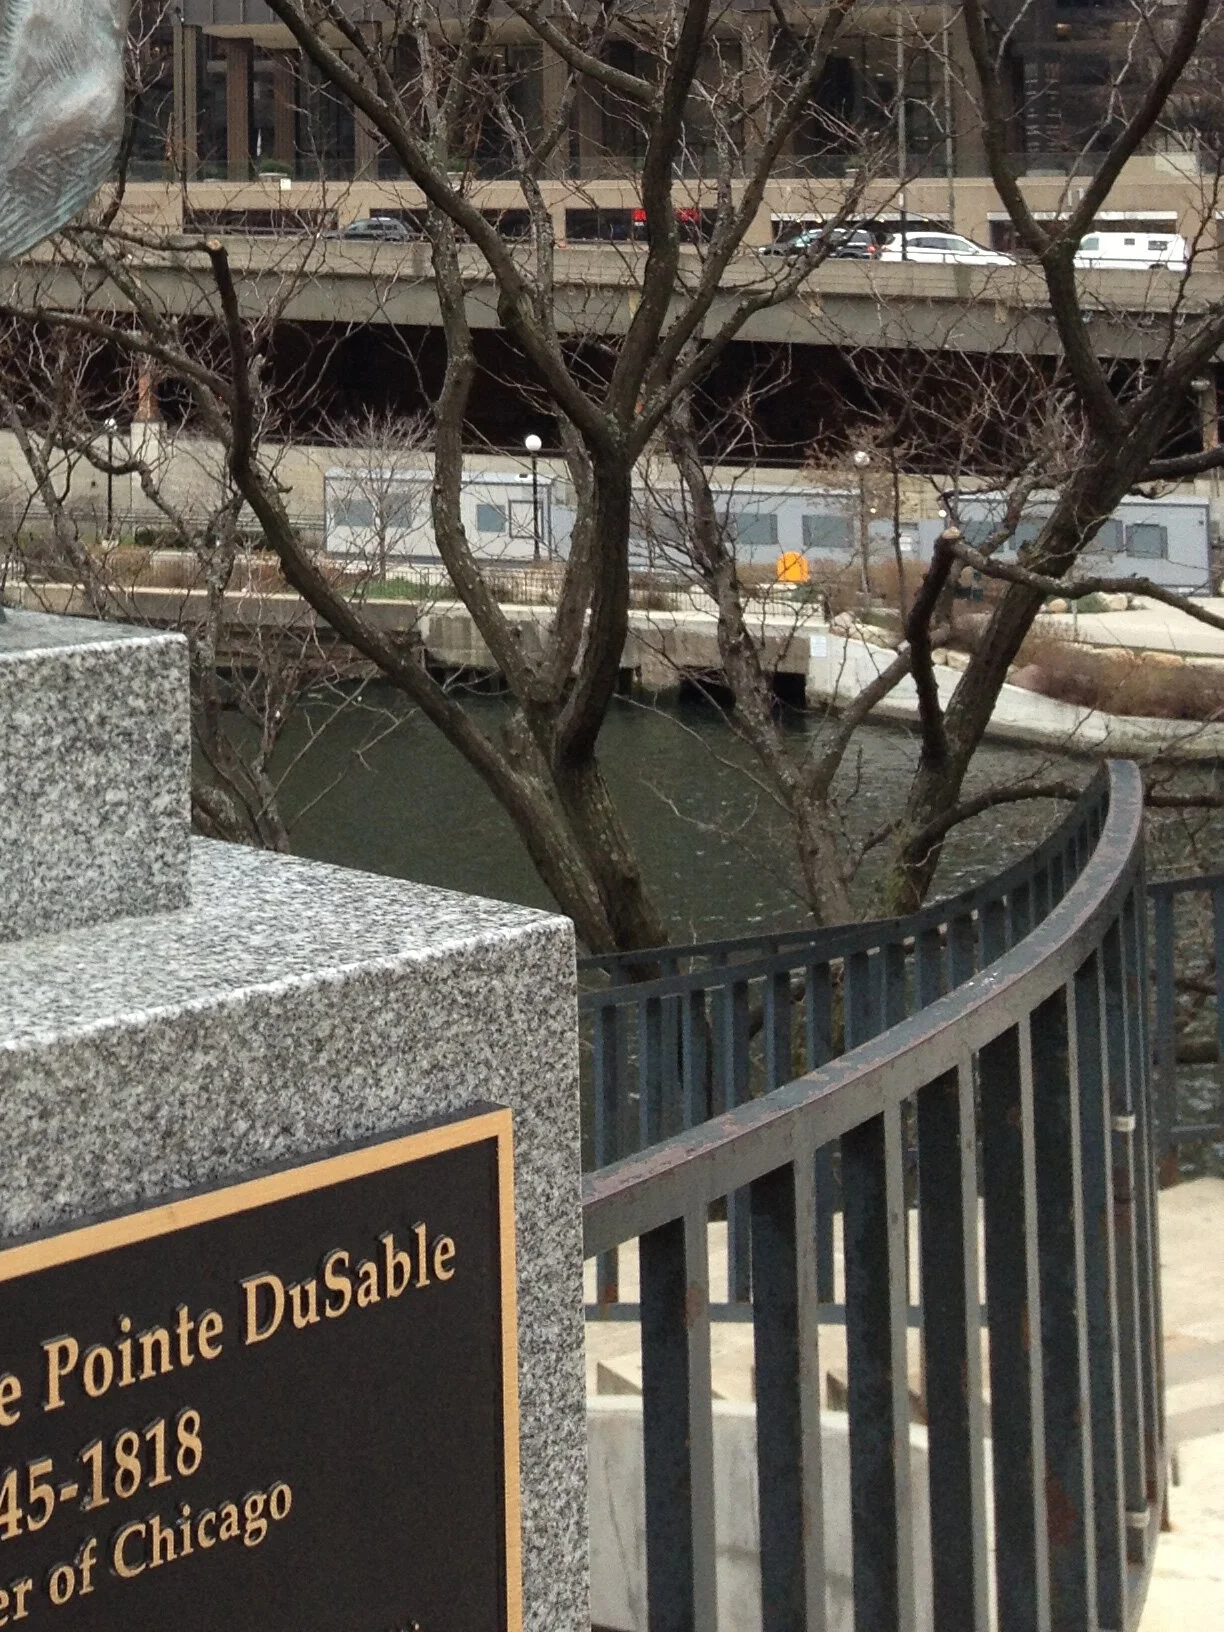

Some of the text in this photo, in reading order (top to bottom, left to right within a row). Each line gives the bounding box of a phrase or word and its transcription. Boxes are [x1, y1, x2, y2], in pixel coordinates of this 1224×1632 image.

[42, 1304, 225, 1413] Pointe
[241, 1222, 457, 1346] DuSable
[48, 1536, 98, 1606] of
[112, 1482, 293, 1579] Chicago
